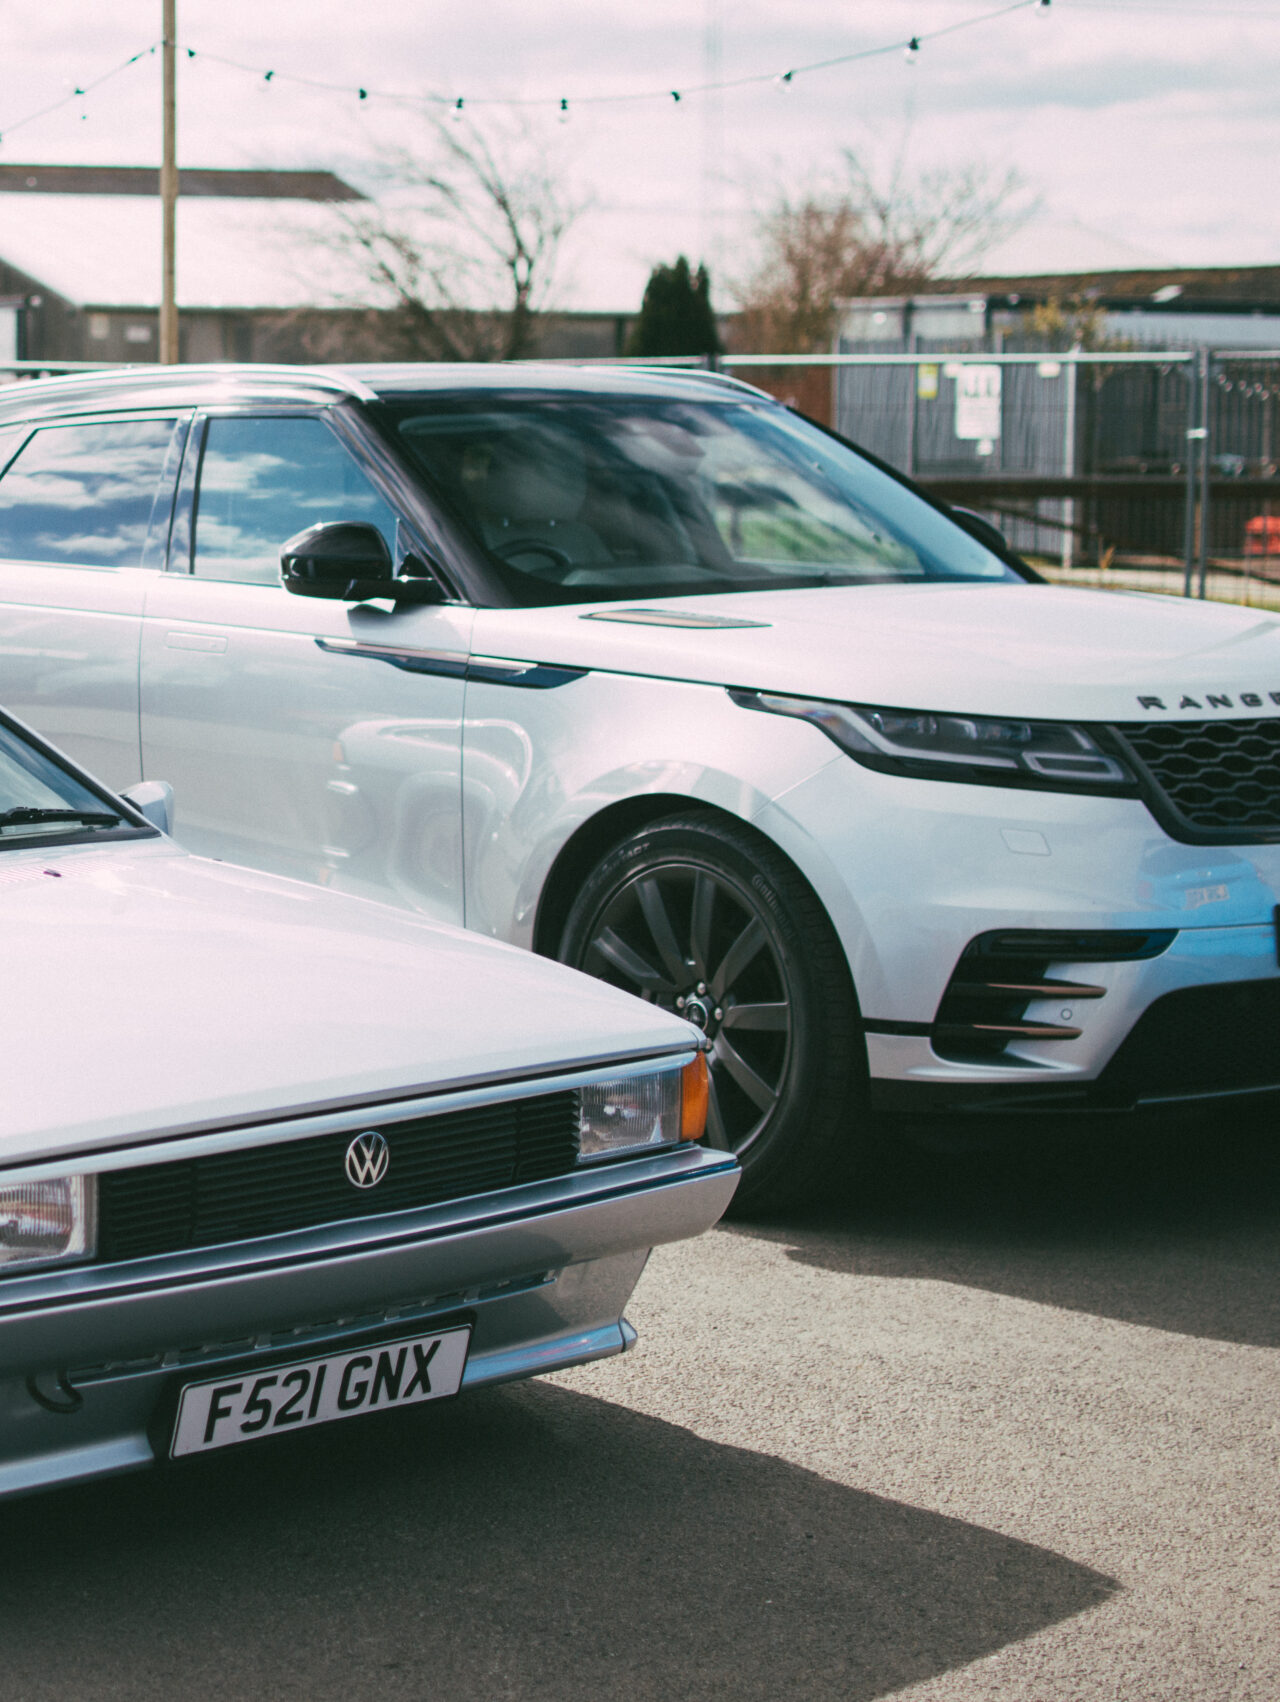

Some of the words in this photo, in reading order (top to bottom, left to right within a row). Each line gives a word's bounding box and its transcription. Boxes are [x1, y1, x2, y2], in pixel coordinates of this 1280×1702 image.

[346, 1131, 389, 1188] VW
[203, 1364, 328, 1444] F521
[337, 1339, 442, 1412] GNX
